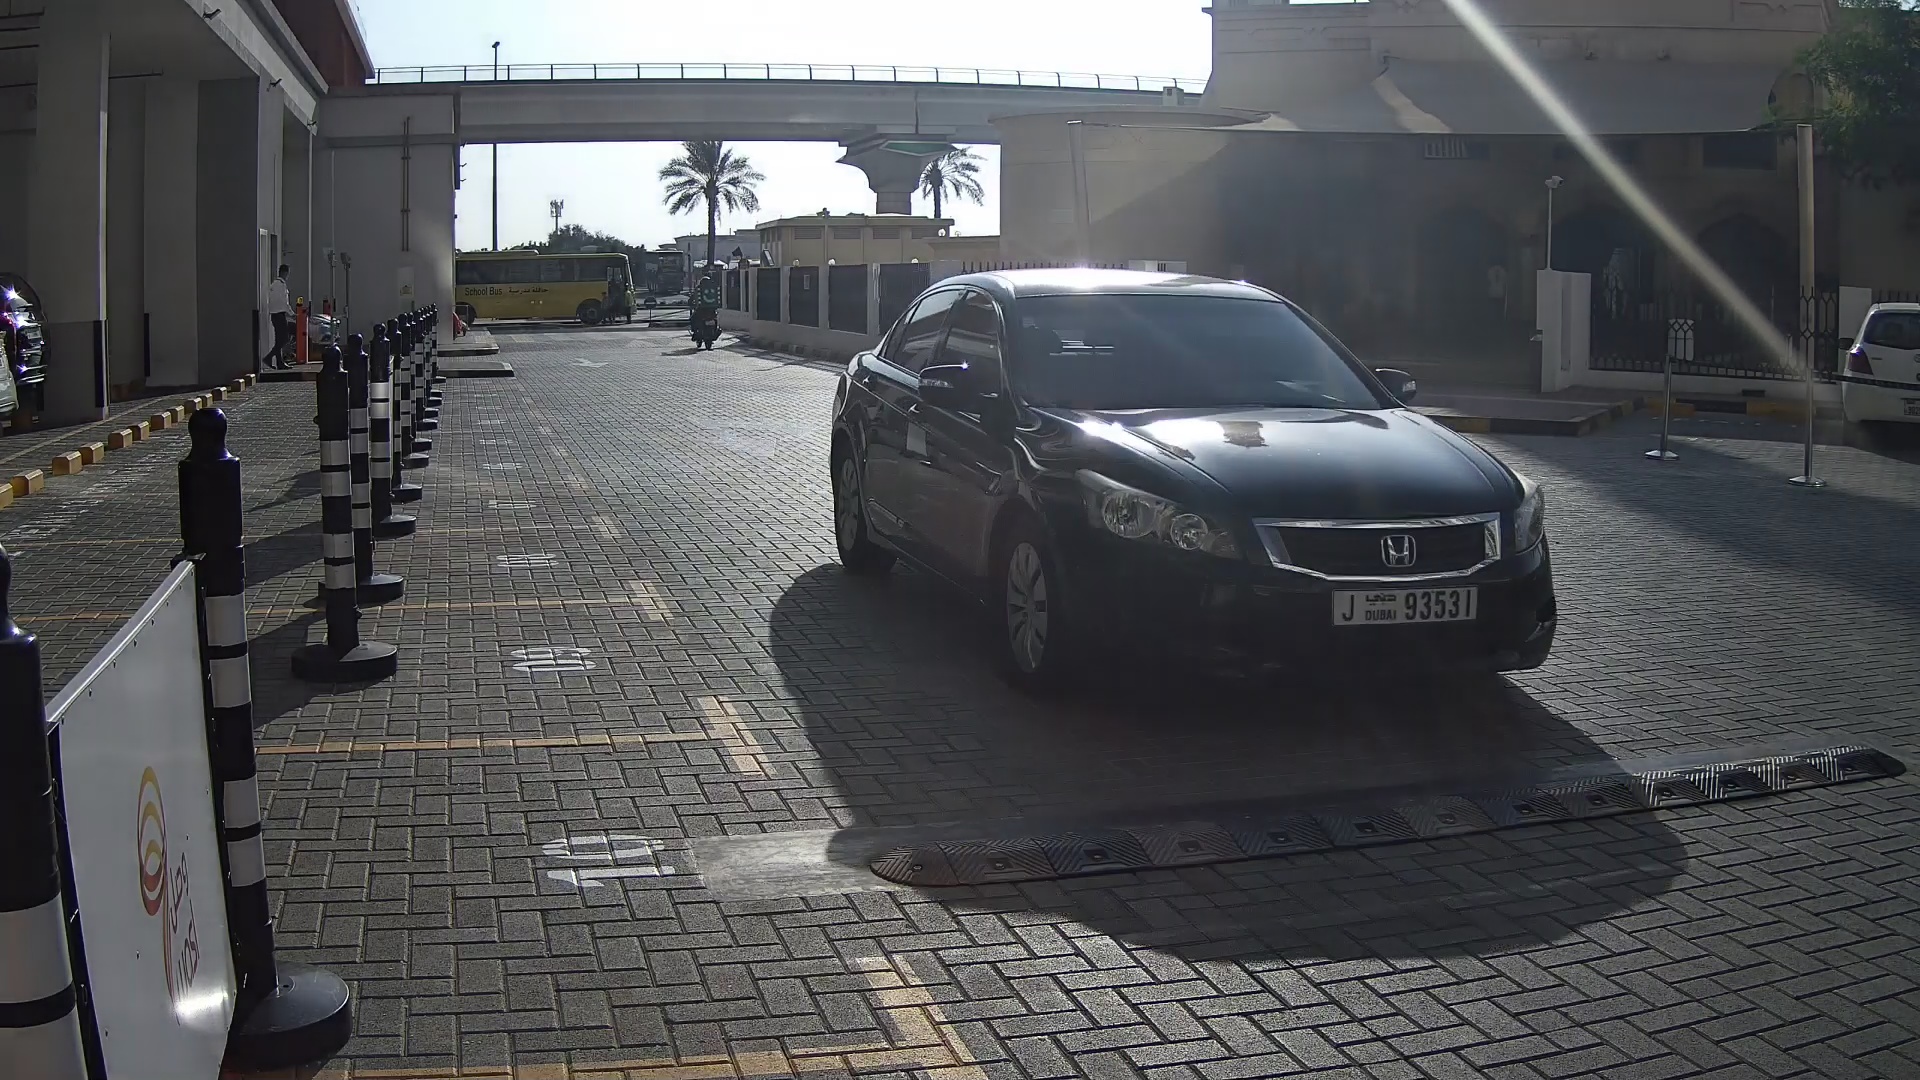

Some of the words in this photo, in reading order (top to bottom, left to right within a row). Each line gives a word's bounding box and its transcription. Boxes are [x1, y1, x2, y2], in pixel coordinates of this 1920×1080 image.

[464, 286, 488, 297] School
[489, 286, 503, 296] Bus
[1342, 594, 1355, 622] J
[1405, 589, 1471, 621] 93531
[1365, 609, 1397, 621] DUBAI
